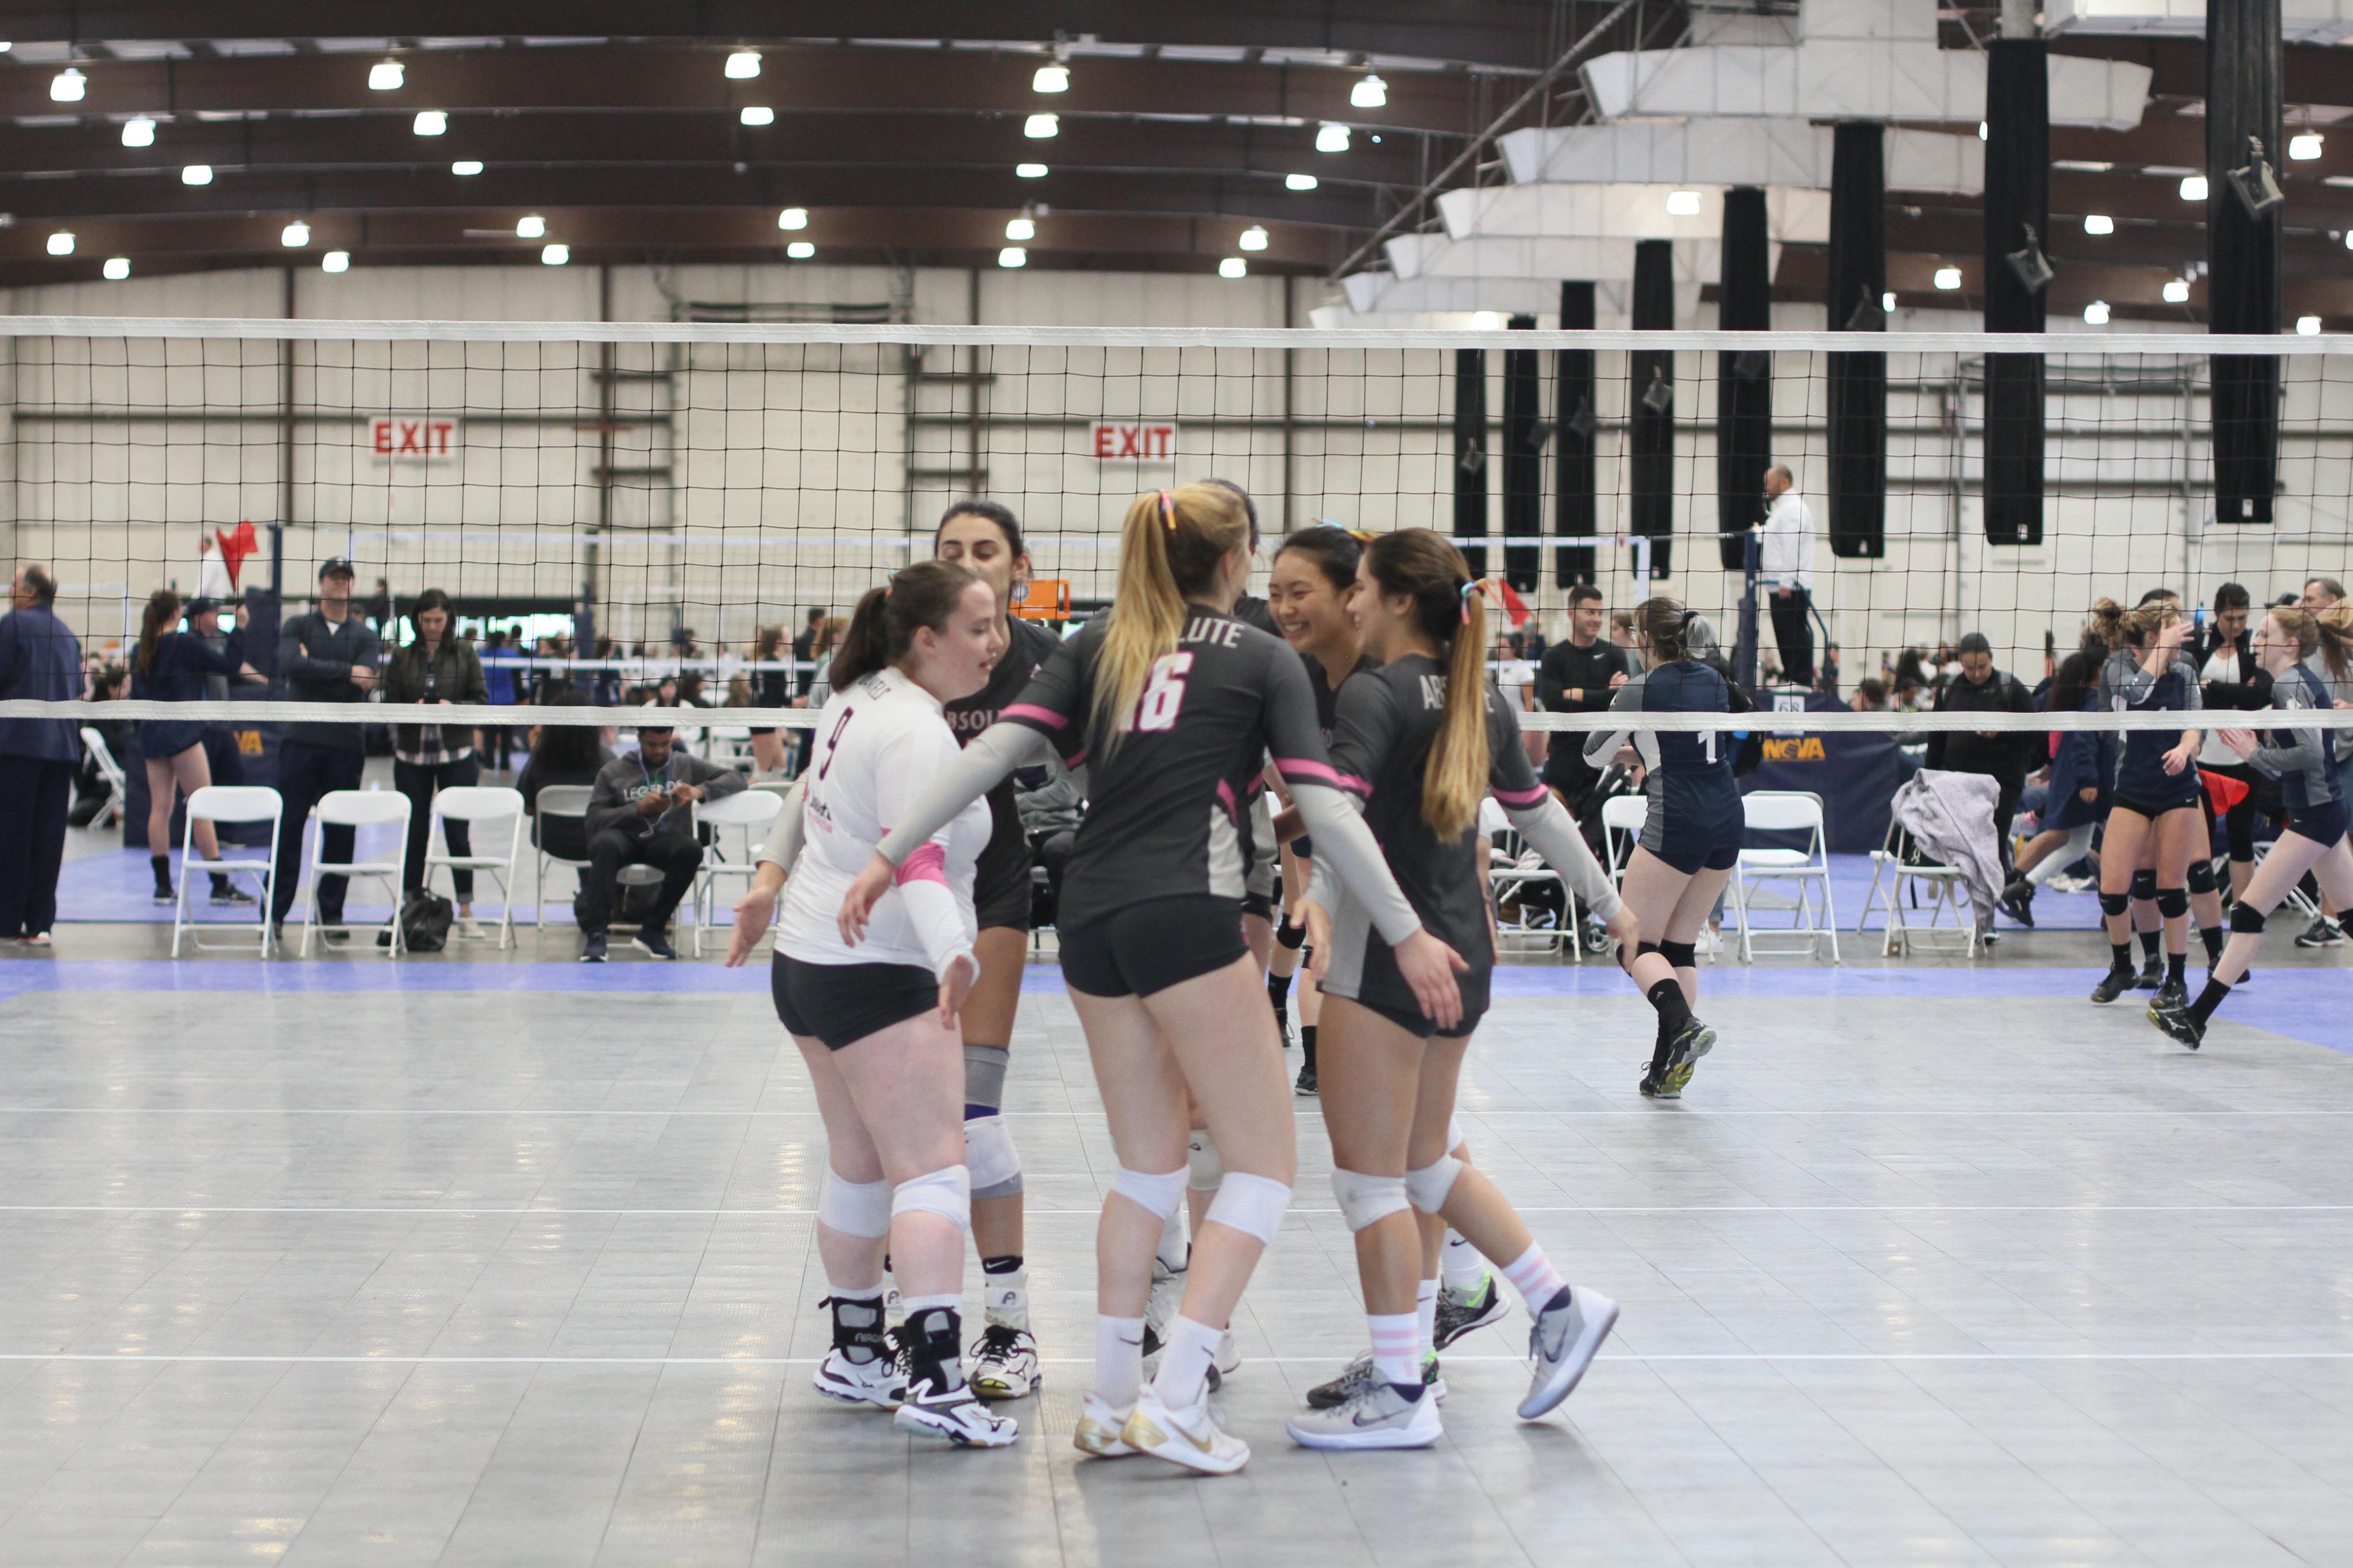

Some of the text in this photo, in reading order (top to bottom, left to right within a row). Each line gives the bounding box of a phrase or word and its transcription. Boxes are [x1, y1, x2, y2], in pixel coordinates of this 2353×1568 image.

[376, 423, 452, 454] EXIT
[1095, 427, 1172, 458] EXIT
[818, 706, 854, 781] 9
